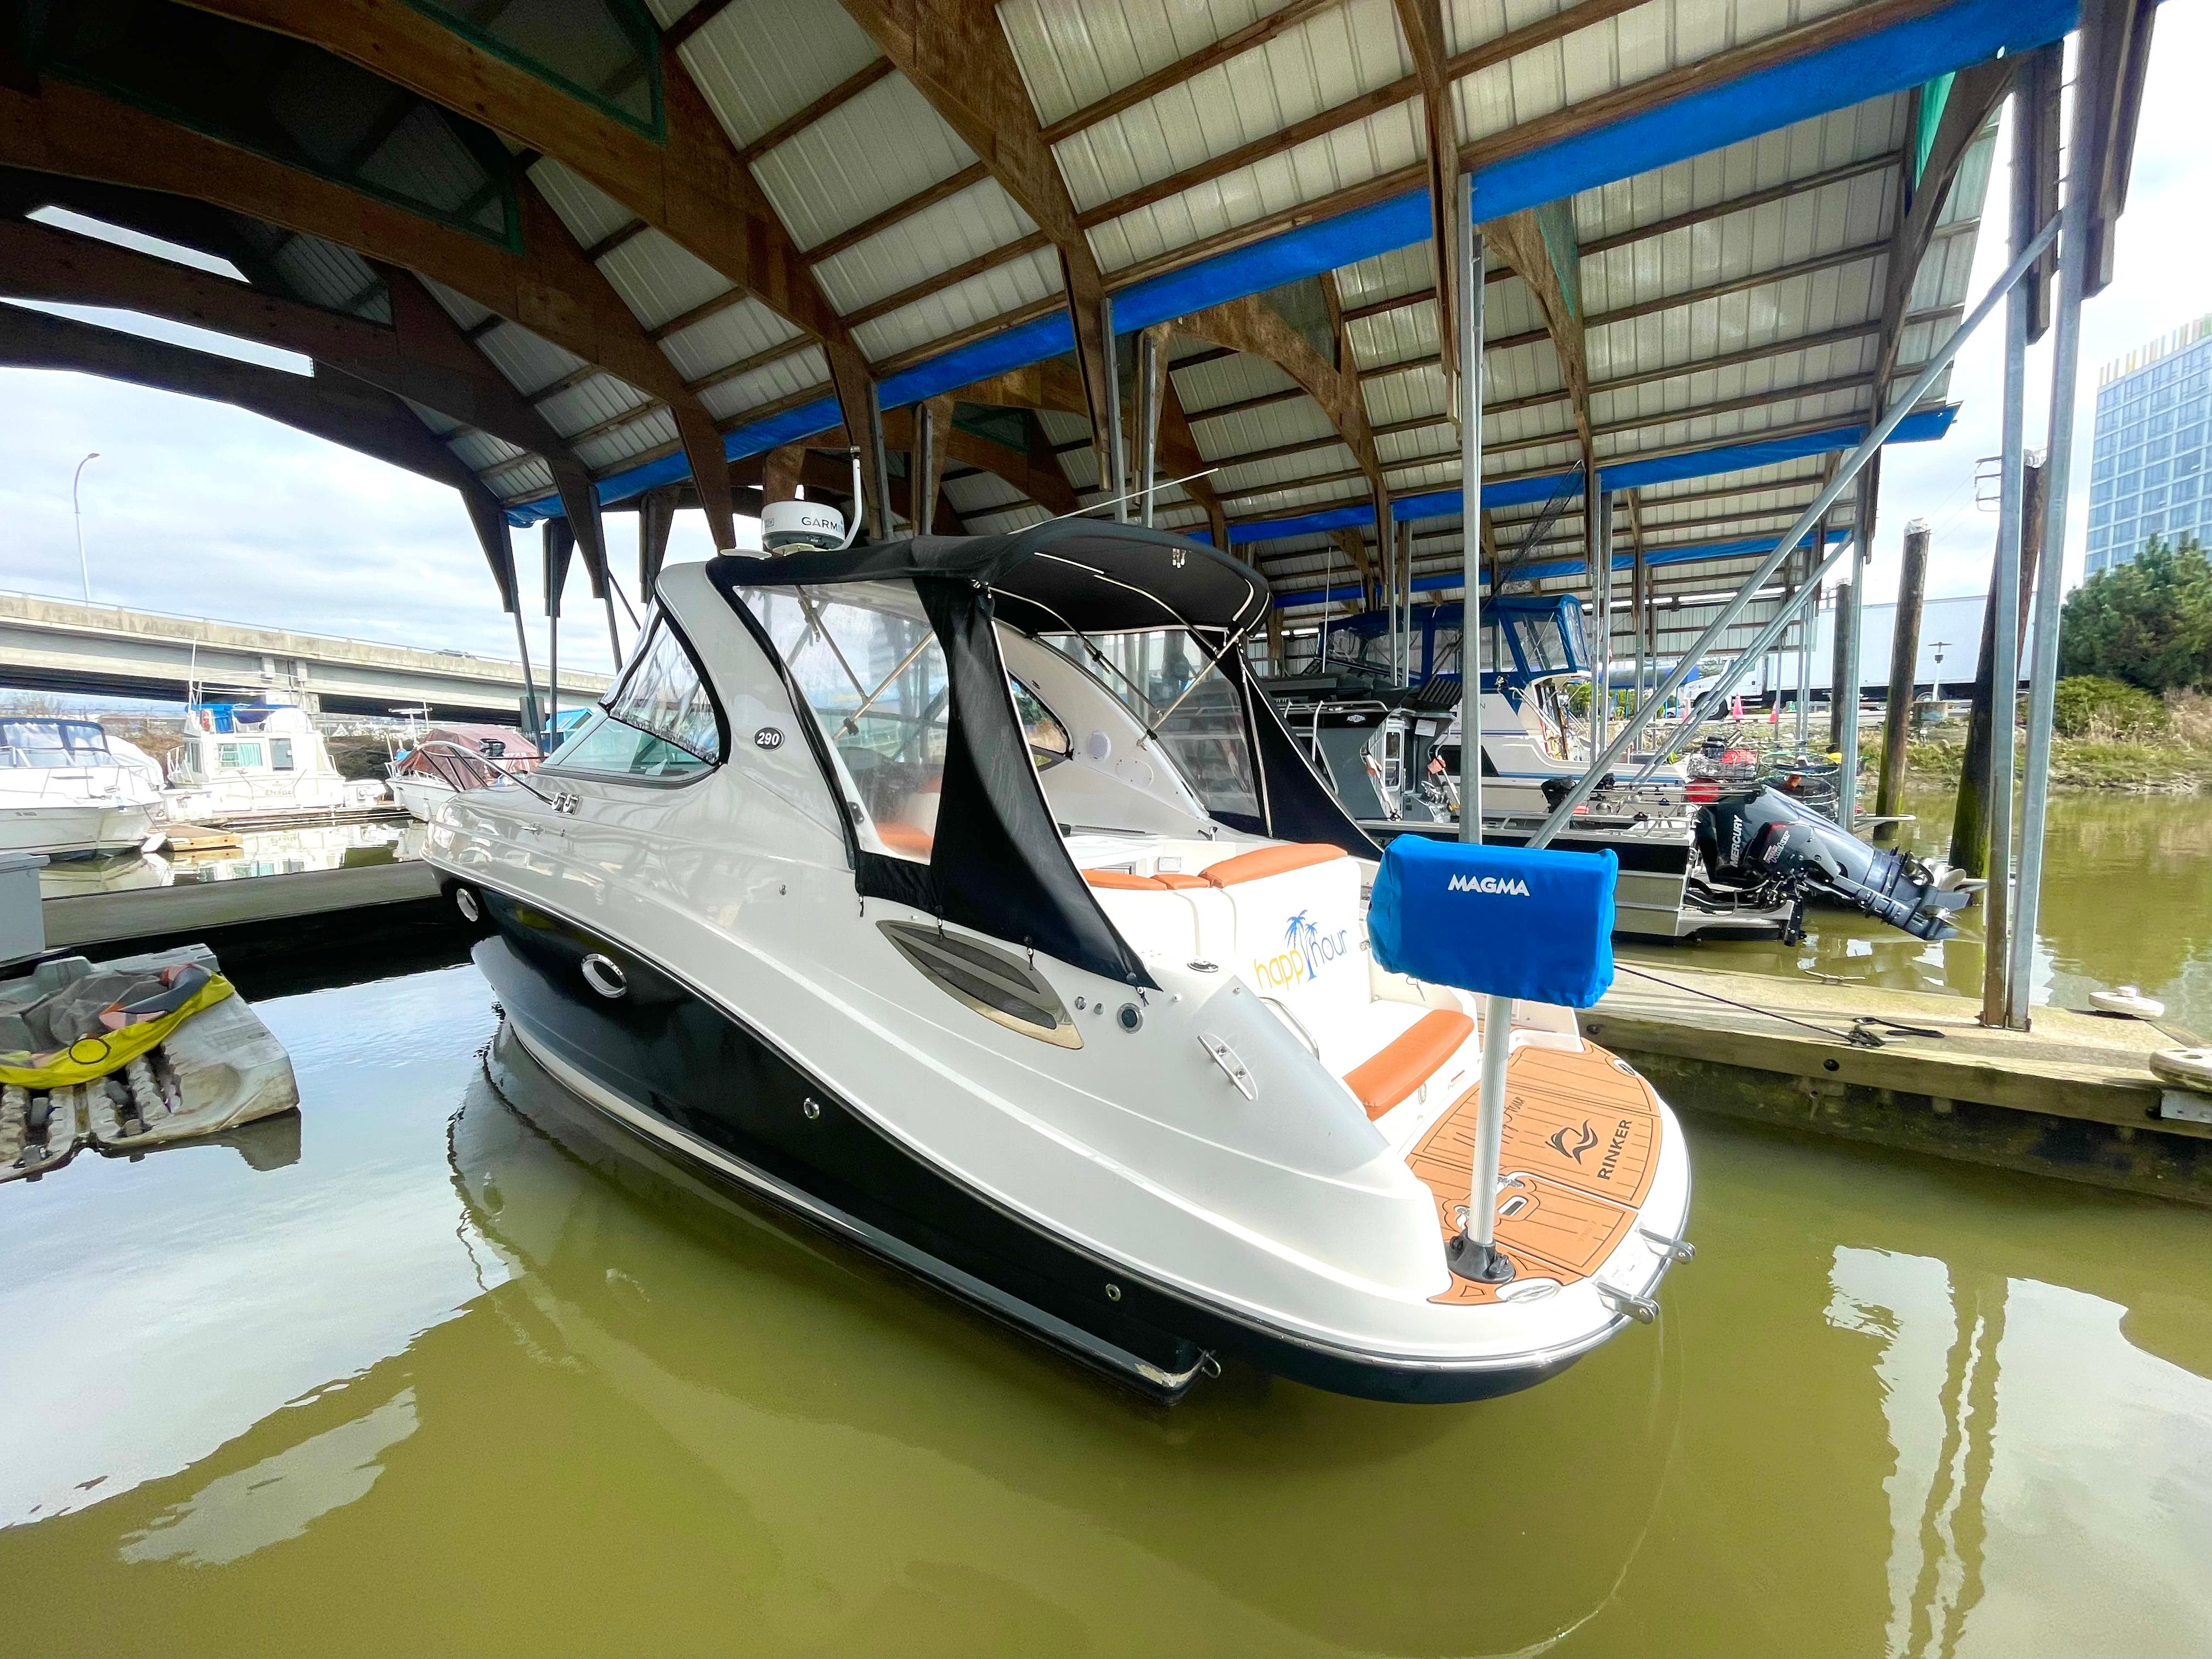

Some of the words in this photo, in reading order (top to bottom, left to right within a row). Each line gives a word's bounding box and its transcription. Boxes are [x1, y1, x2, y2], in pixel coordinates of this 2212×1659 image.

[801, 516, 844, 534] GARMIN
[757, 732, 780, 746] 290
[1729, 814, 1743, 868] MERCURY
[1448, 873, 1530, 896] MAGMA
[1596, 1120, 1633, 1180] RINKER
